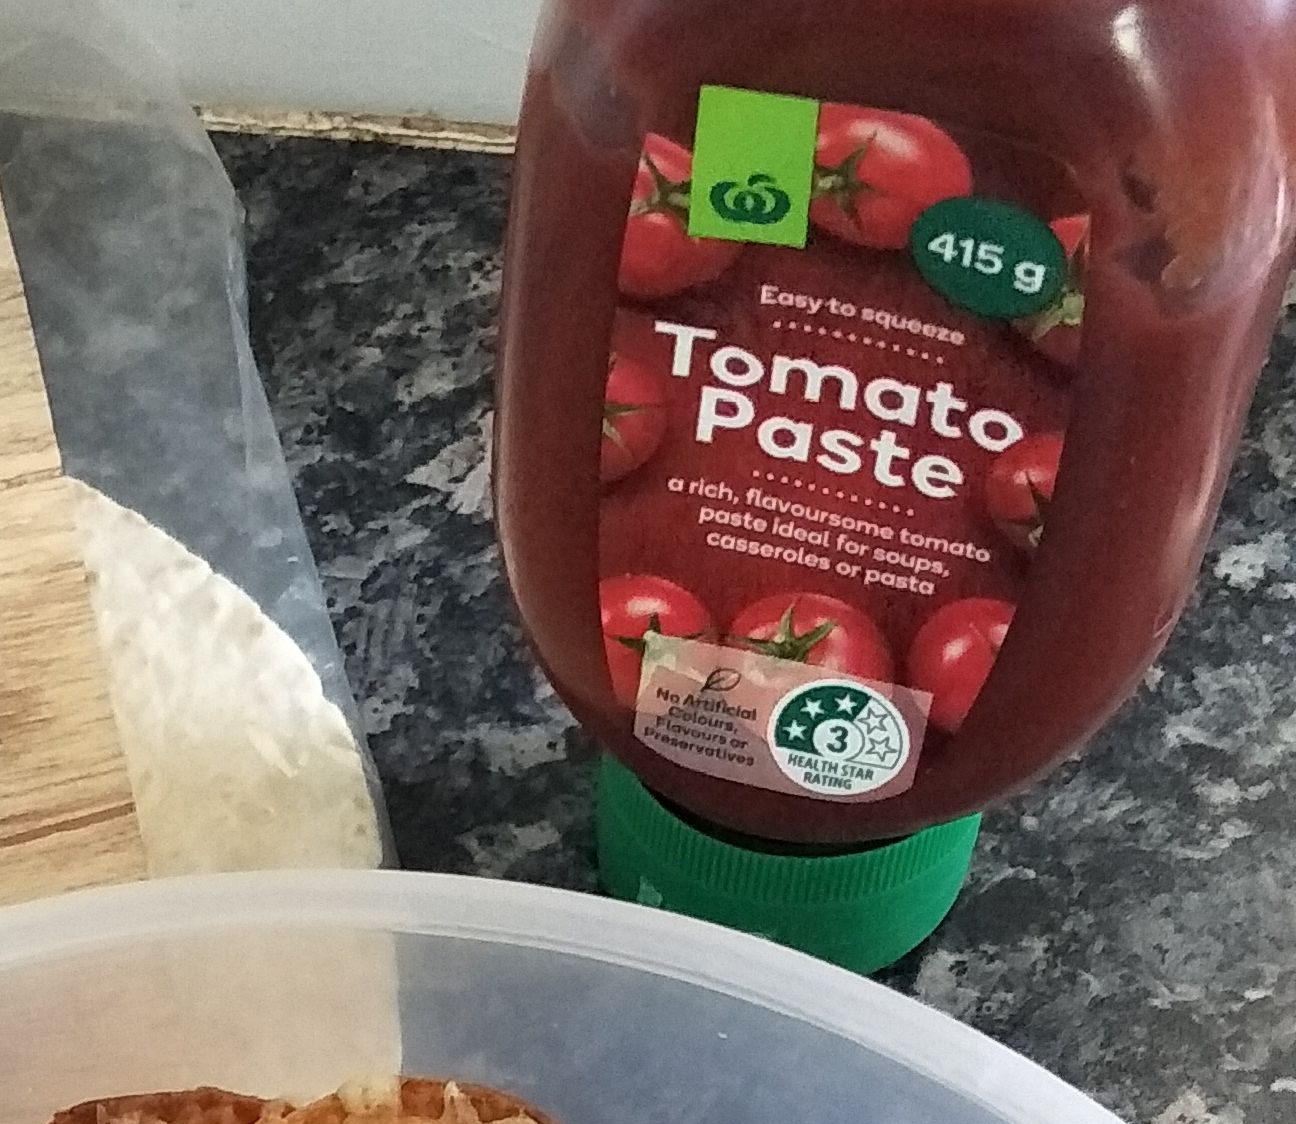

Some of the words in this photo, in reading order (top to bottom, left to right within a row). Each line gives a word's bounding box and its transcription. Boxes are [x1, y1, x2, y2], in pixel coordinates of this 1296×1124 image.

[927, 232, 1005, 275] 415
[1013, 260, 1046, 294] g
[760, 284, 823, 315] Easy
[825, 297, 857, 318] to
[861, 307, 966, 345] squeeze
[654, 320, 1024, 452] Tomato
[695, 386, 964, 498] Paste
[667, 477, 684, 493] a
[688, 477, 739, 505] rich,
[746, 487, 895, 540] flavoursome
[899, 528, 991, 563] tomato
[698, 505, 767, 533] paste
[771, 516, 830, 548] ideal
[836, 534, 870, 556] for
[873, 548, 950, 578] soups,
[706, 530, 830, 571] casseroles
[835, 560, 862, 578] or
[864, 568, 935, 596] pasta
[656, 687, 680, 704] No
[683, 694, 757, 721] Artificial
[656, 715, 727, 745] Flavours
[730, 738, 749, 749] or
[668, 705, 738, 735] Colours,
[787, 753, 838, 774] HEALTH
[841, 764, 874, 781] STAR
[826, 725, 848, 753] 3
[803, 771, 852, 790] RATING
